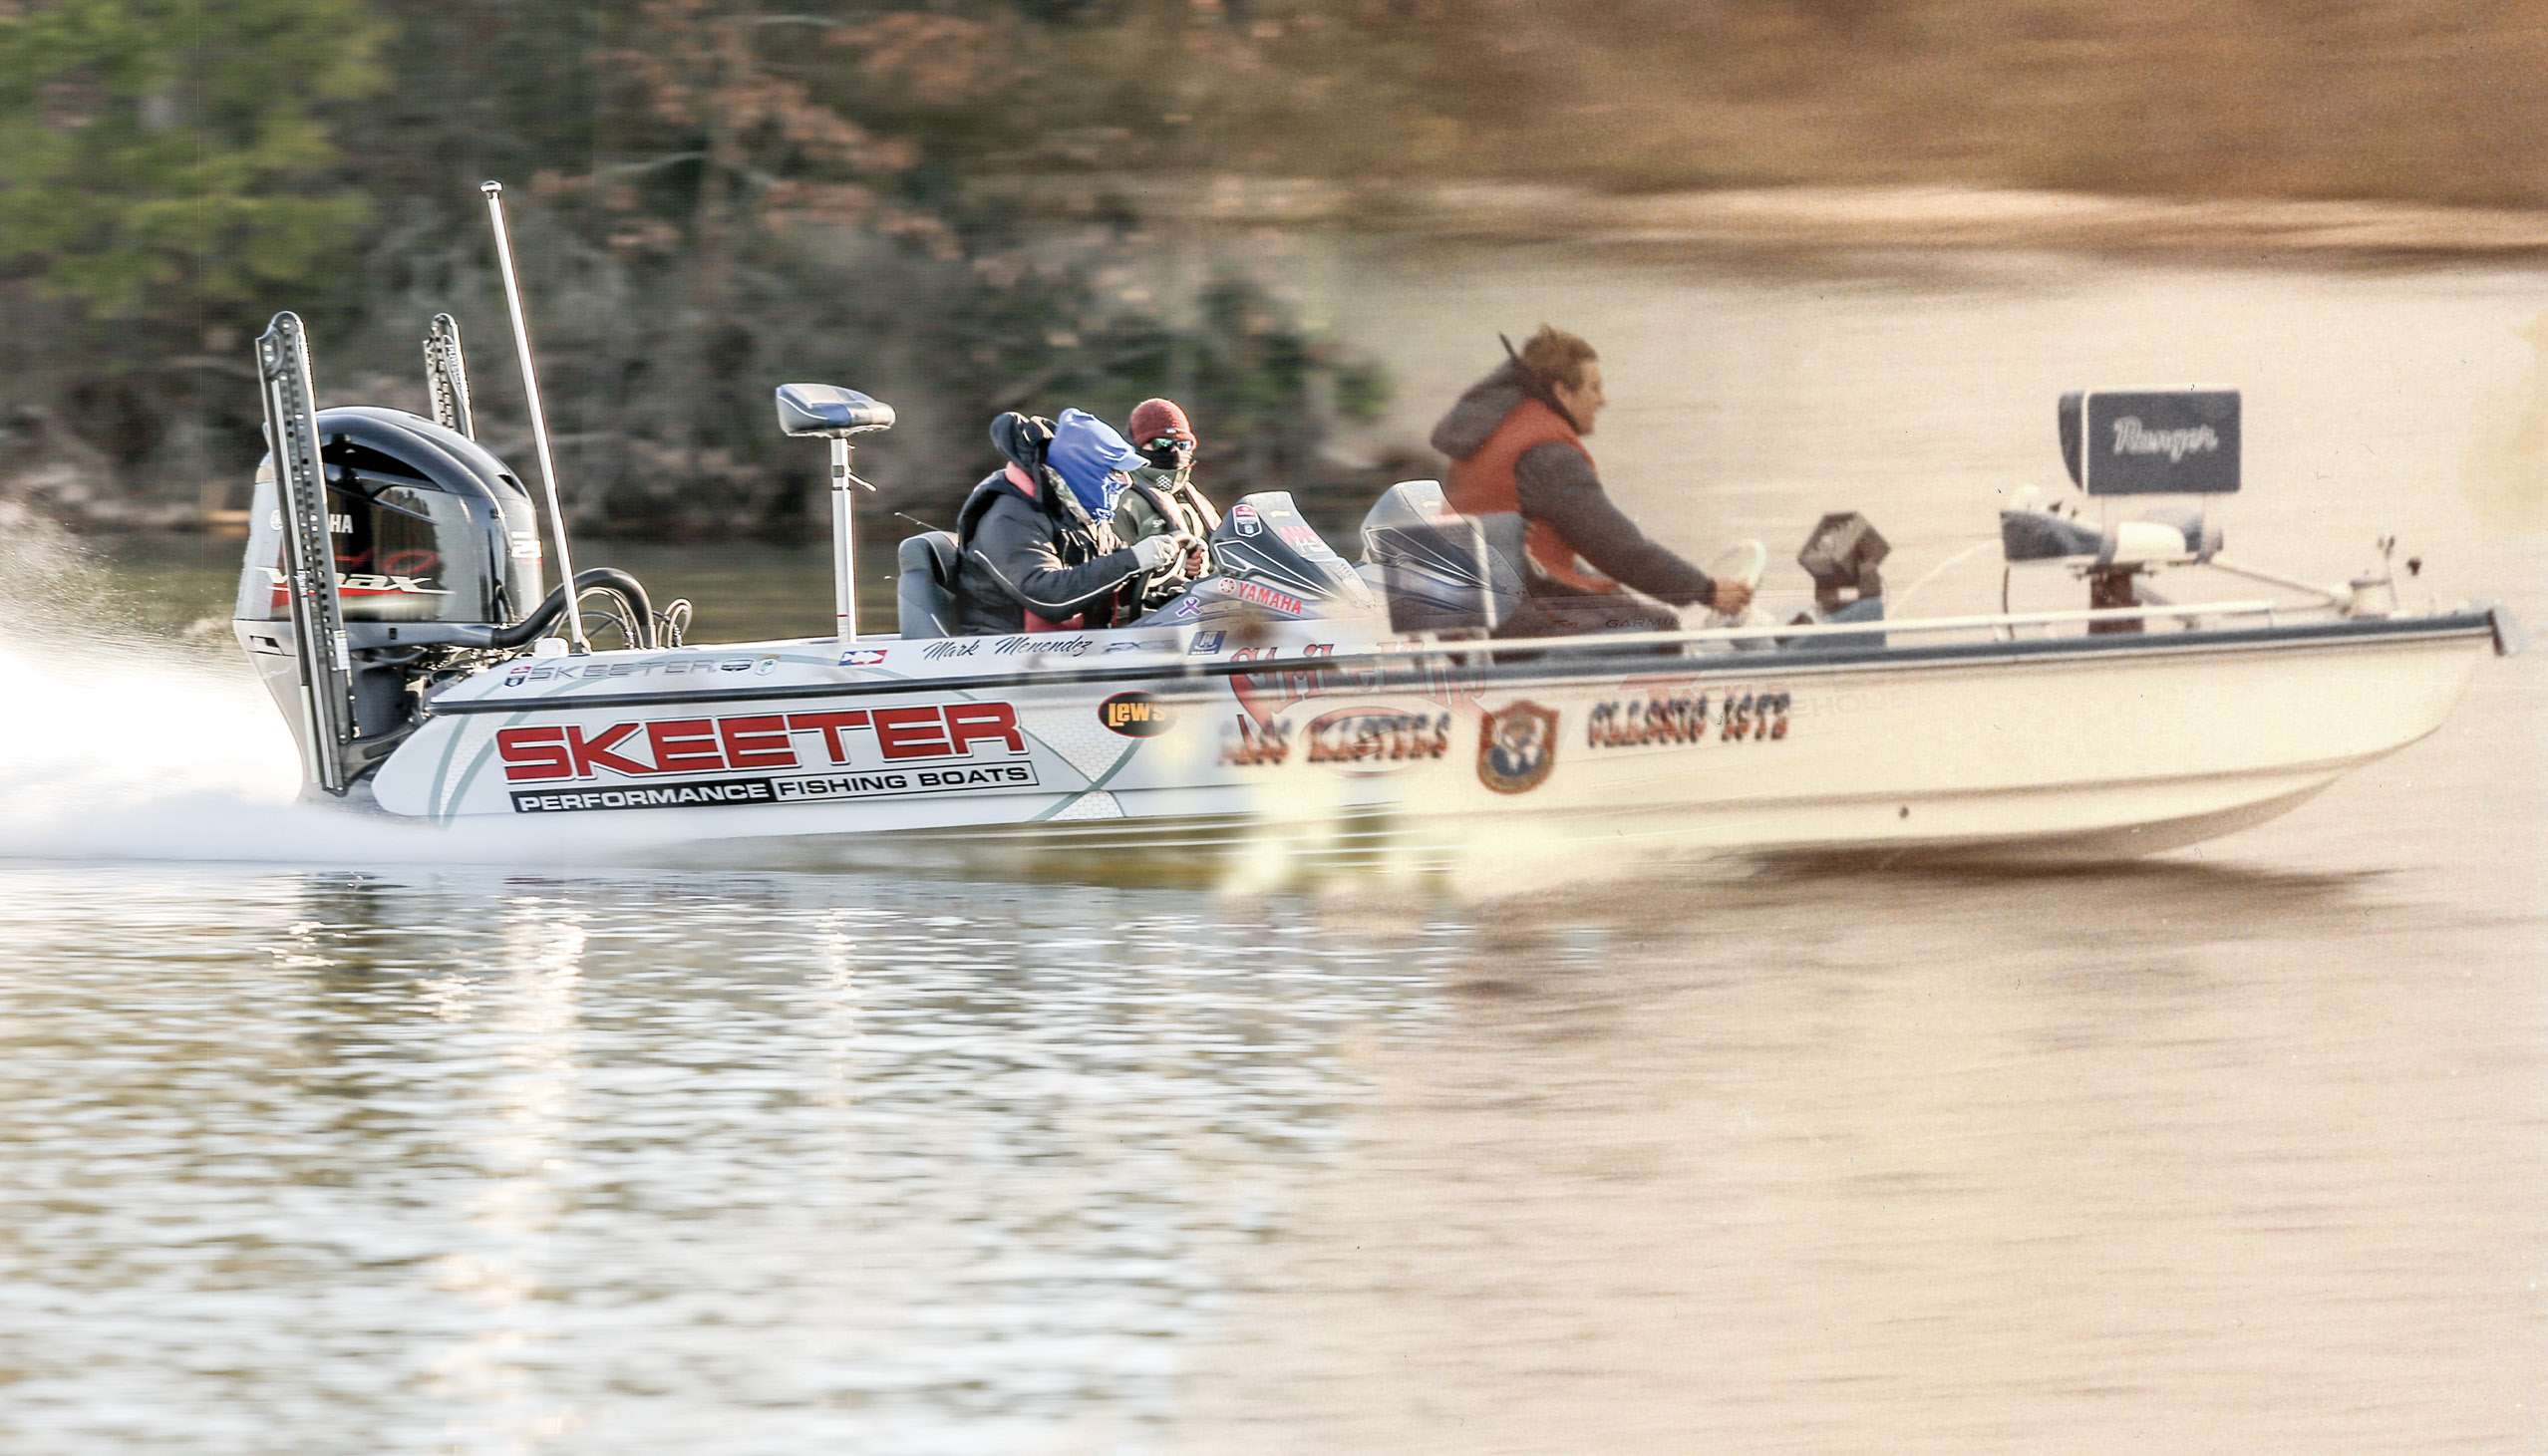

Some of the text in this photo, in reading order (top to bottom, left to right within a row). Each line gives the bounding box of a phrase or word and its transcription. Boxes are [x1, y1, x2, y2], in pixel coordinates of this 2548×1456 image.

[1237, 582, 1303, 615] YAMAHA
[923, 641, 981, 661] Mark
[528, 658, 715, 682] SKEETER
[496, 700, 1030, 783] SKEETER
[519, 765, 1030, 813] PERFORMANCE FISHING BOATS
